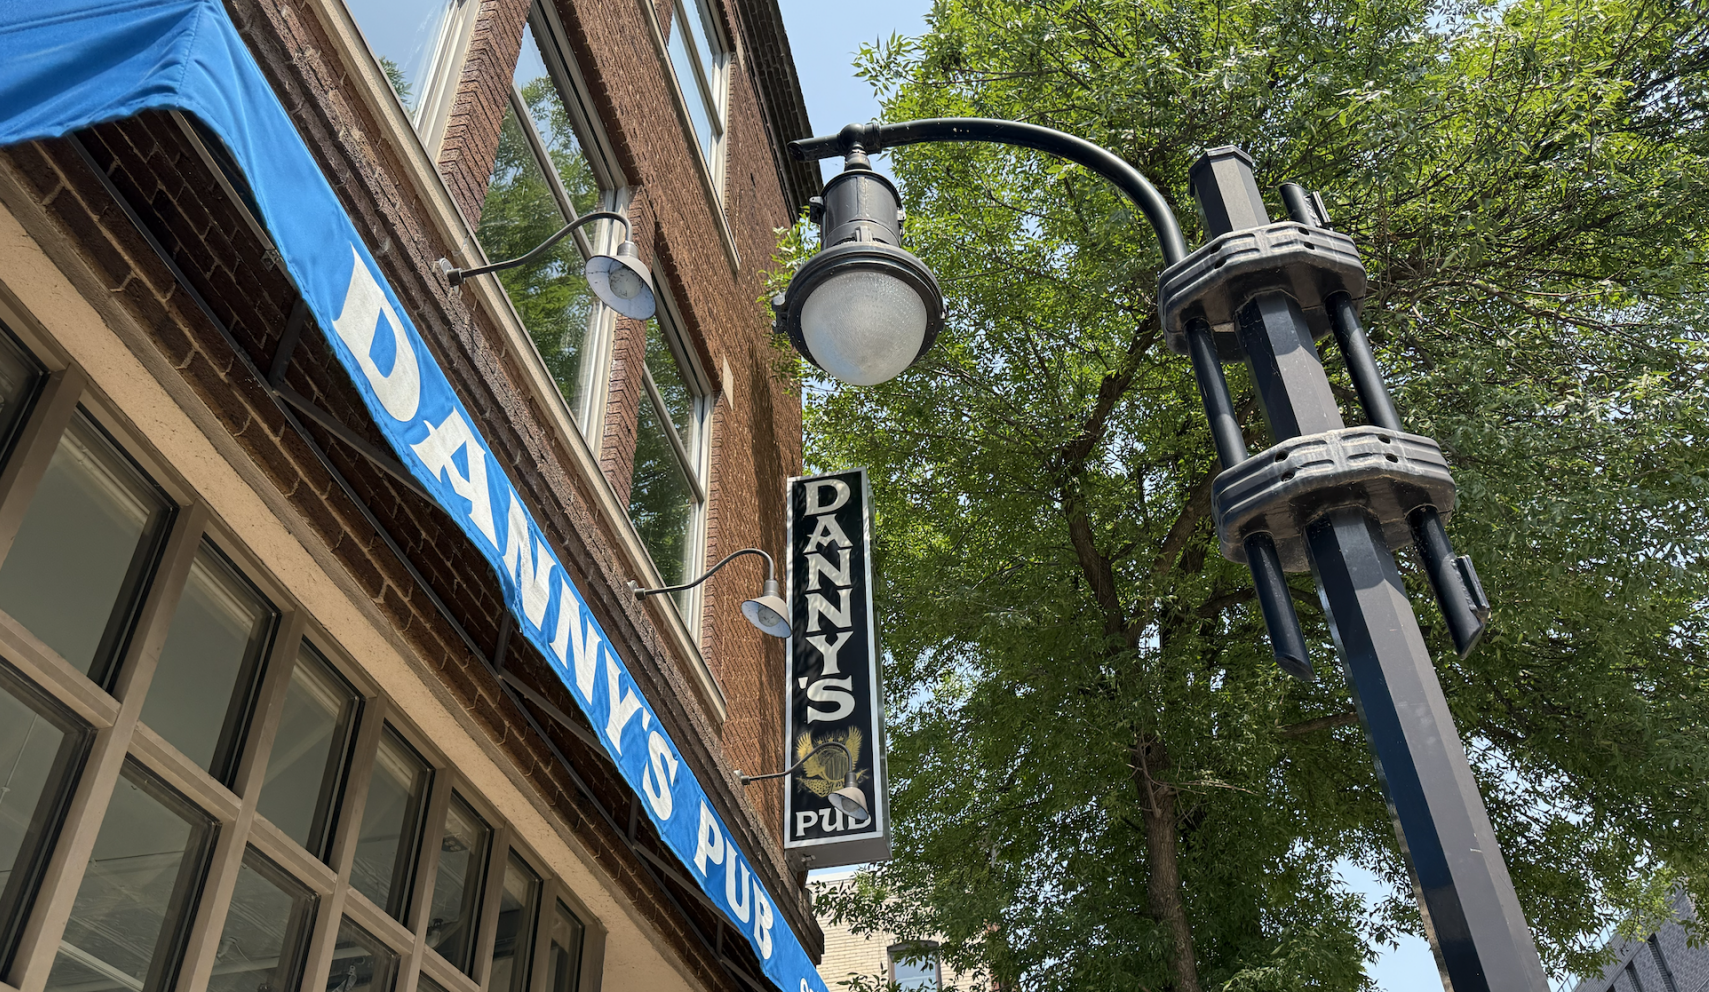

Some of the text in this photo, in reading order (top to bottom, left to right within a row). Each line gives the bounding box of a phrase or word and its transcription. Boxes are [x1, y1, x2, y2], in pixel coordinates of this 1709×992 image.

[332, 243, 774, 960] DANNY'S PUB
[798, 478, 855, 725] DANNY'S
